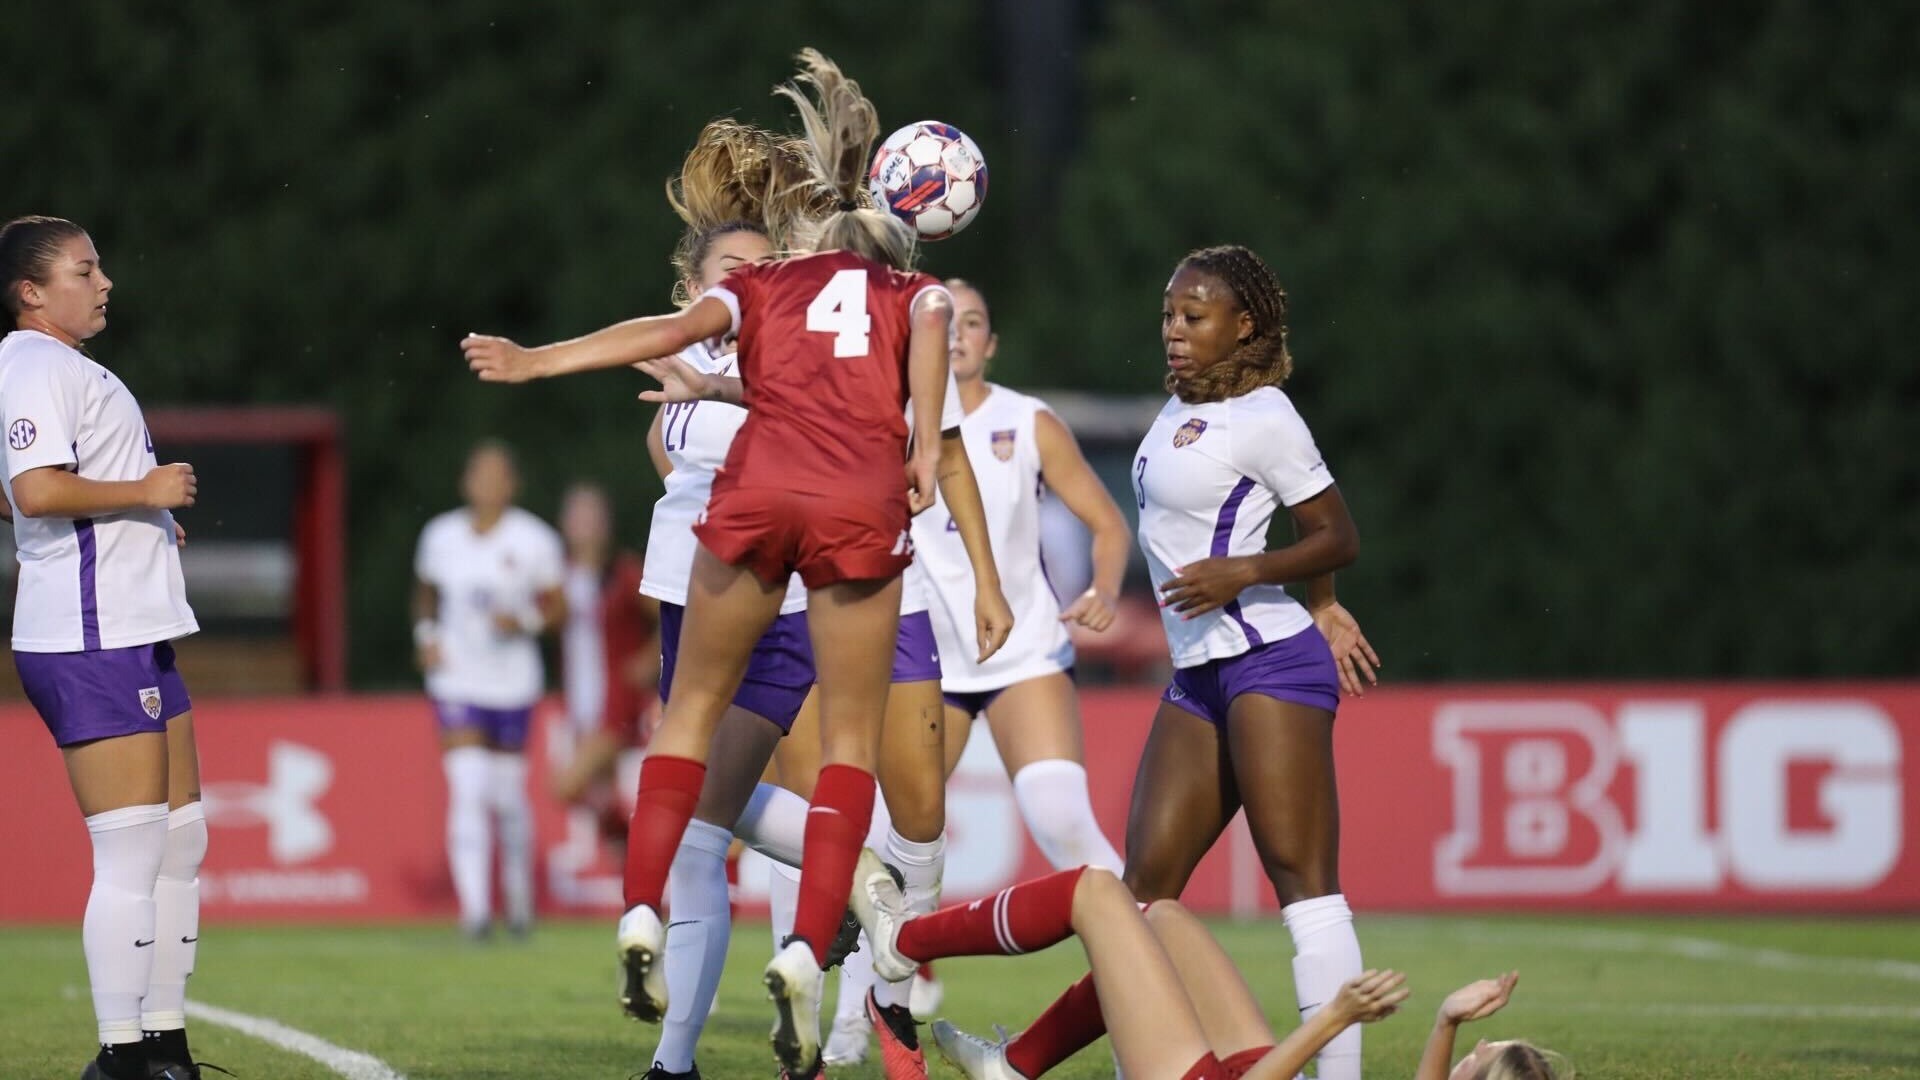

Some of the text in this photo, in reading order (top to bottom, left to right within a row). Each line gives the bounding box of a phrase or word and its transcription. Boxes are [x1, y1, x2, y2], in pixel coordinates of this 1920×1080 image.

[883, 156, 904, 184] GAME
[806, 269, 871, 358] 4
[10, 420, 35, 449] SEC
[666, 401, 699, 451] 27
[1137, 456, 1148, 509] 3
